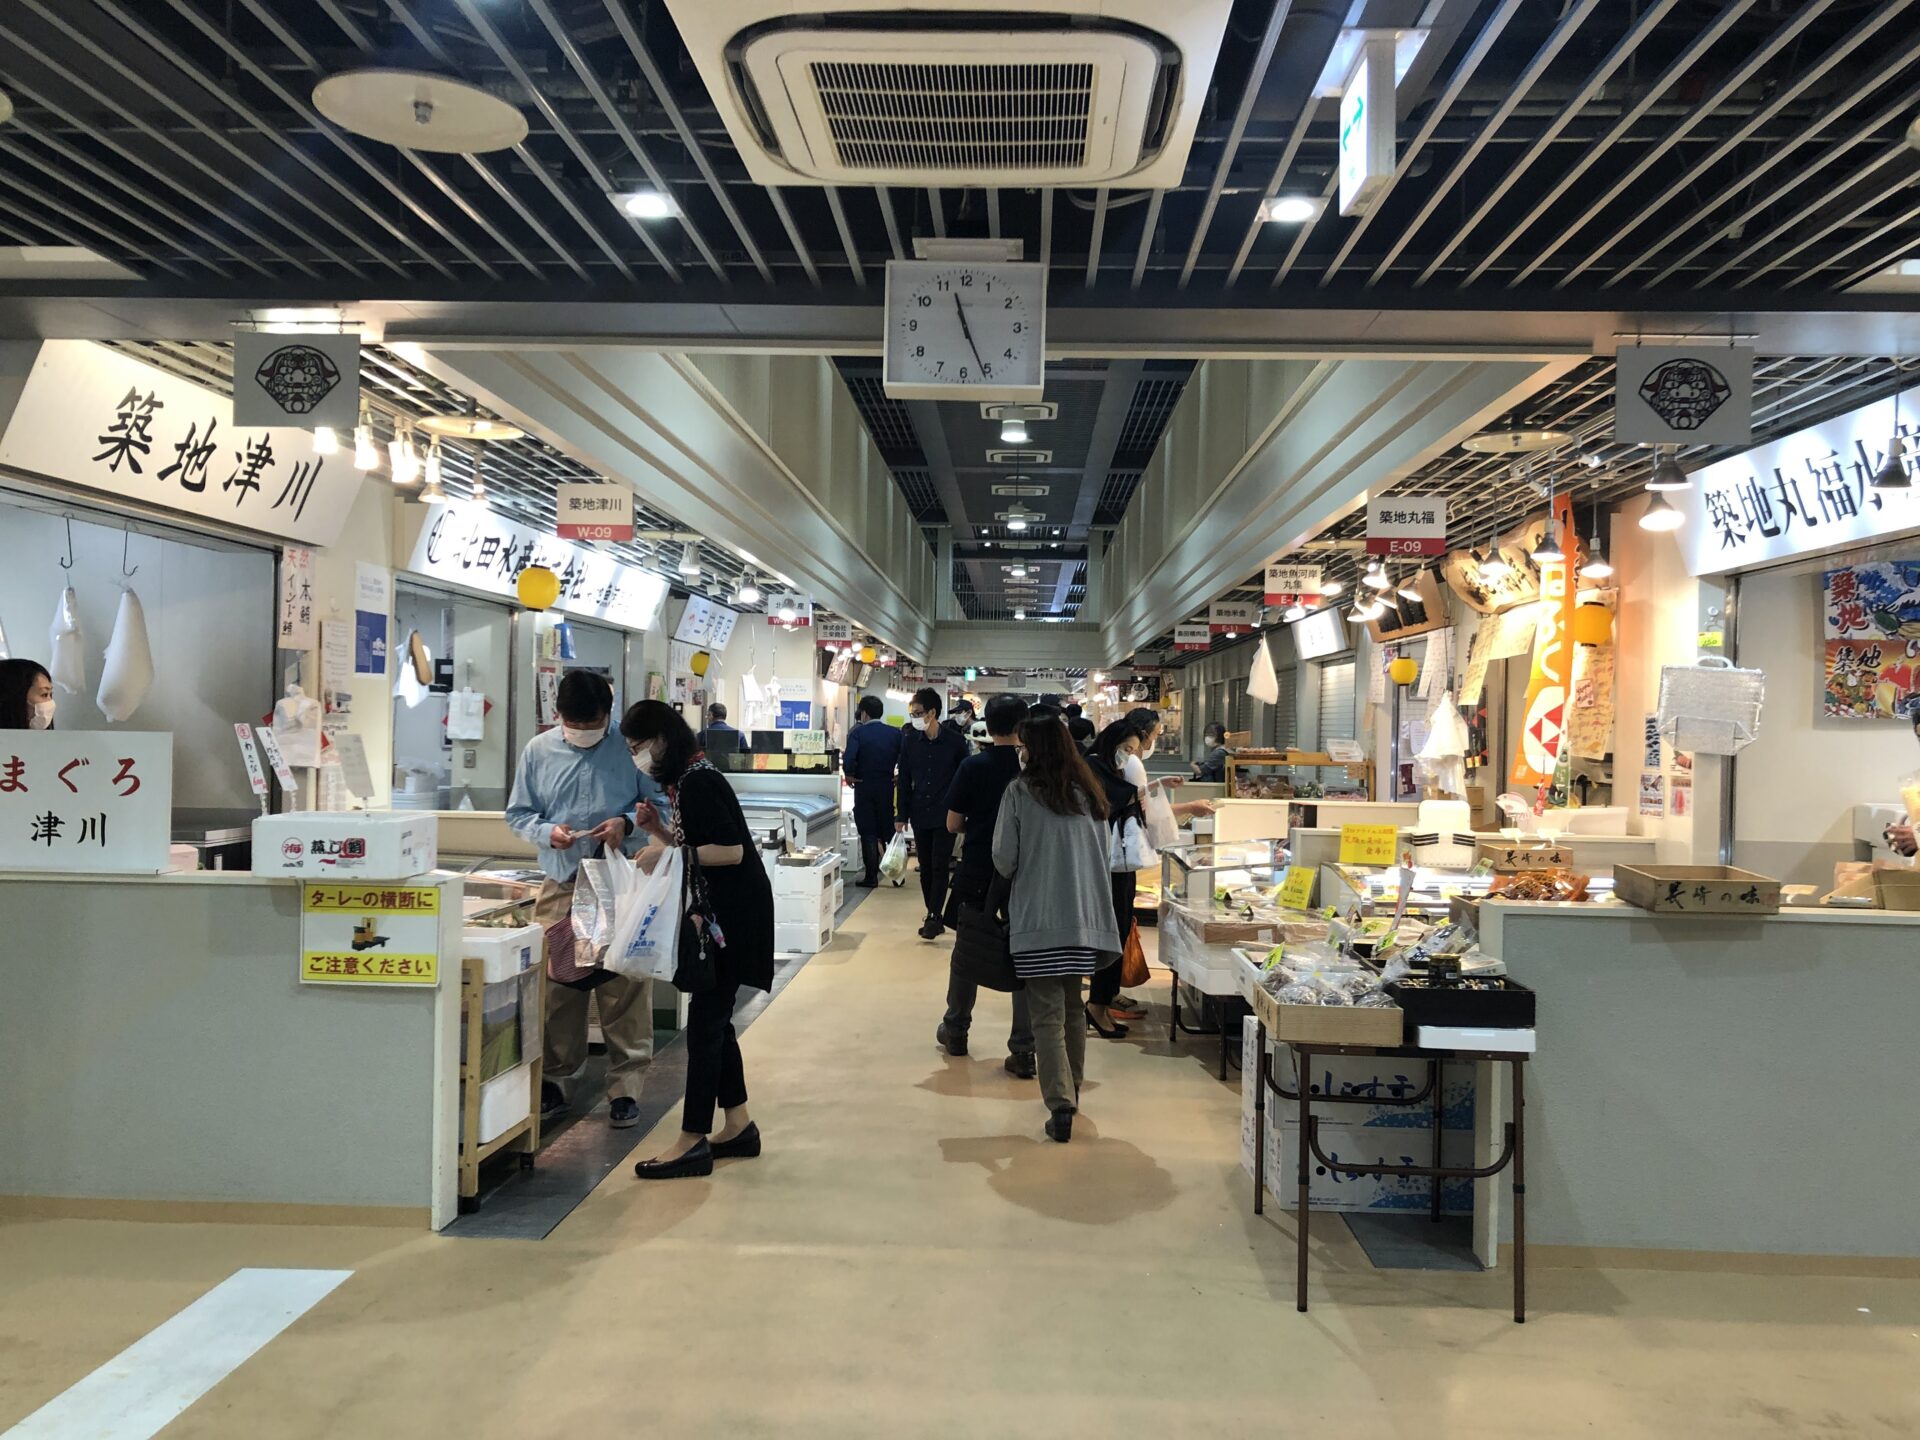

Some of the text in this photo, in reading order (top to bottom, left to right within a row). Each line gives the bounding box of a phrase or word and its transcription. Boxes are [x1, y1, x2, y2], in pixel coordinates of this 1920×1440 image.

[937, 280, 950, 291] 11
[959, 274, 973, 287] 12
[985, 281, 991, 293] 1
[918, 295, 932, 307] 10
[1004, 297, 1013, 310] 2
[908, 319, 918, 332] 9
[1012, 321, 1022, 334] 3
[916, 345, 925, 358] 8
[1003, 348, 1013, 360] 4
[936, 361, 945, 373] 7
[959, 366, 968, 379] 6
[983, 362, 992, 375] 5
[93, 386, 324, 523] 築地津川
[568, 497, 622, 512] 築地津川
[1379, 510, 1435, 525] 築地丸福
[576, 526, 612, 539] W-09
[1389, 540, 1423, 553] E-09
[1830, 569, 1869, 636] 築地
[1221, 624, 1239, 633] E-11
[1184, 643, 1200, 651] E-12
[1834, 642, 1883, 674] 築地
[0, 755, 141, 797] まぐろ
[30, 810, 107, 848] 津川
[310, 889, 433, 909] ターレーの横断に
[308, 955, 432, 976] ご注意ください
